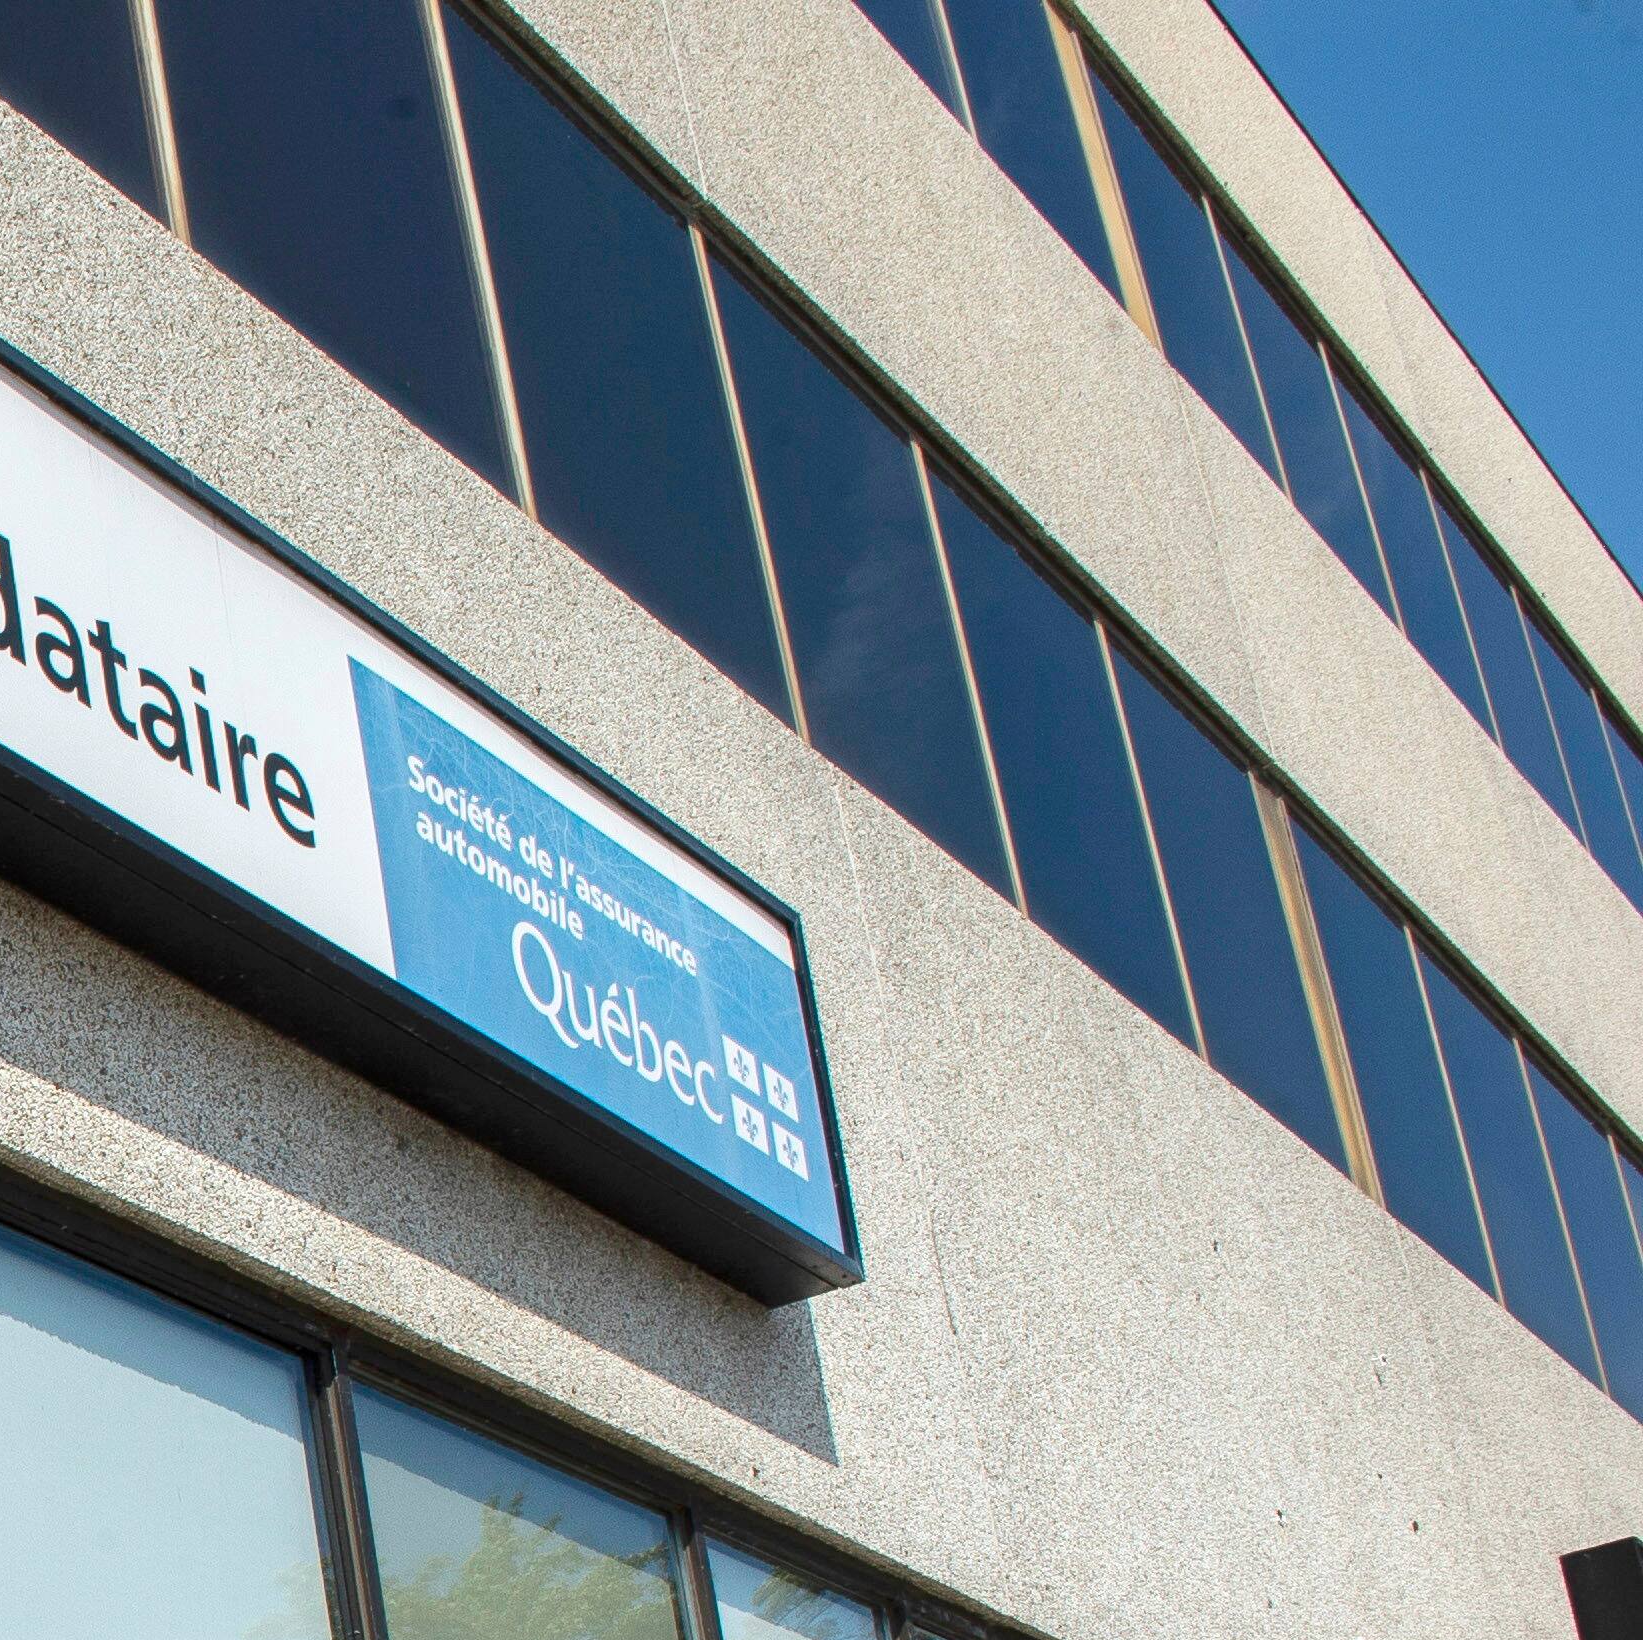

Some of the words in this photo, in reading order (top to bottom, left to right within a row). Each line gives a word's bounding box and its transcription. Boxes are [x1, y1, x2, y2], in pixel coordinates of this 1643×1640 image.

[408, 756, 512, 851] Société
[519, 833, 553, 877] de
[560, 856, 698, 977] l'assurance
[415, 810, 585, 941] automobile
[512, 921, 724, 1124] Québec
